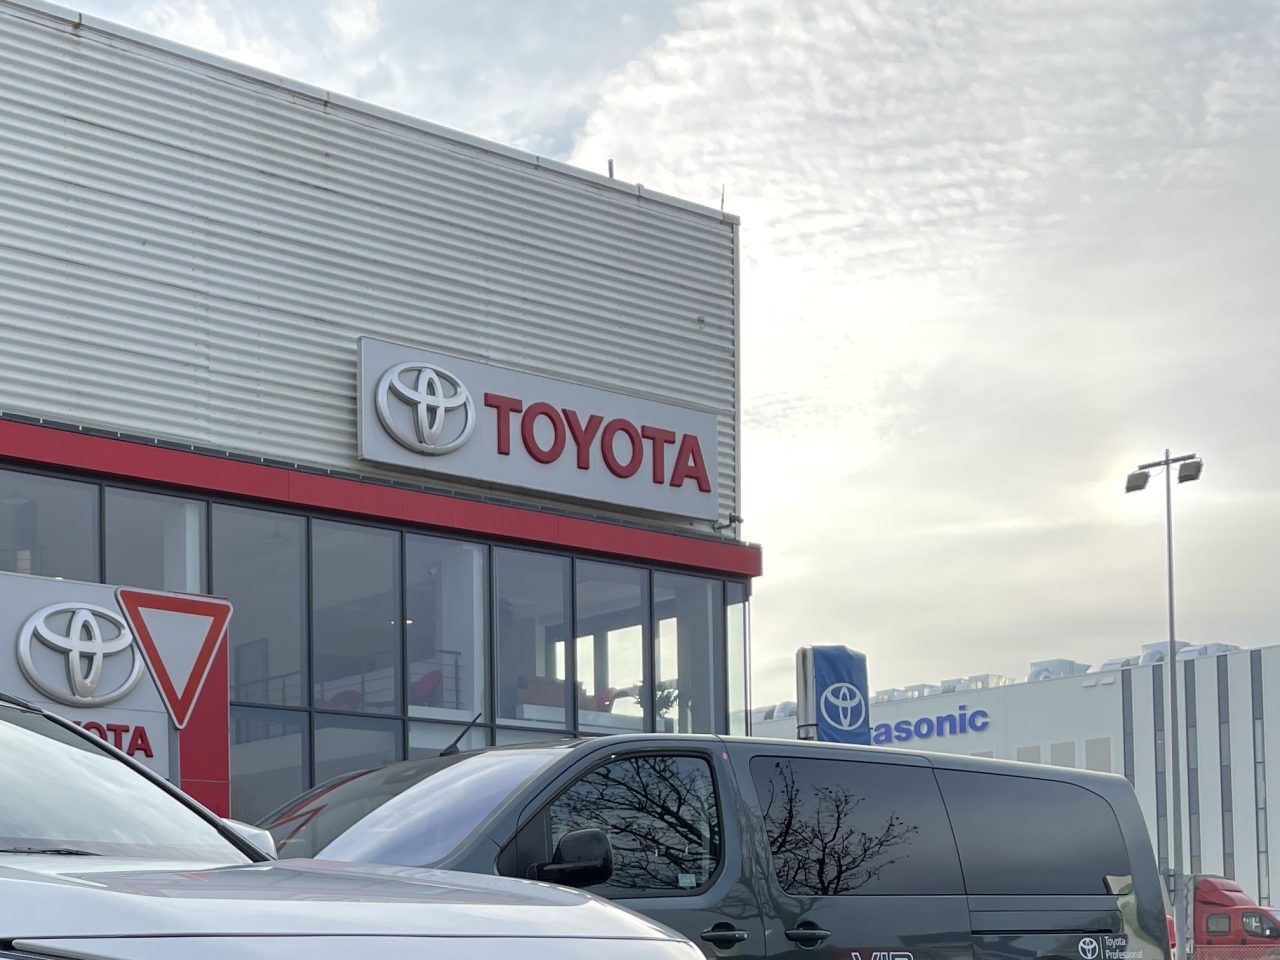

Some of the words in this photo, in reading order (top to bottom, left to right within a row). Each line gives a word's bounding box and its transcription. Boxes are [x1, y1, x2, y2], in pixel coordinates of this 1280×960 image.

[484, 392, 711, 493] TOYOTA
[873, 705, 989, 744] asonic
[1104, 936, 1126, 948] Toyota
[1105, 949, 1143, 959] Professional
